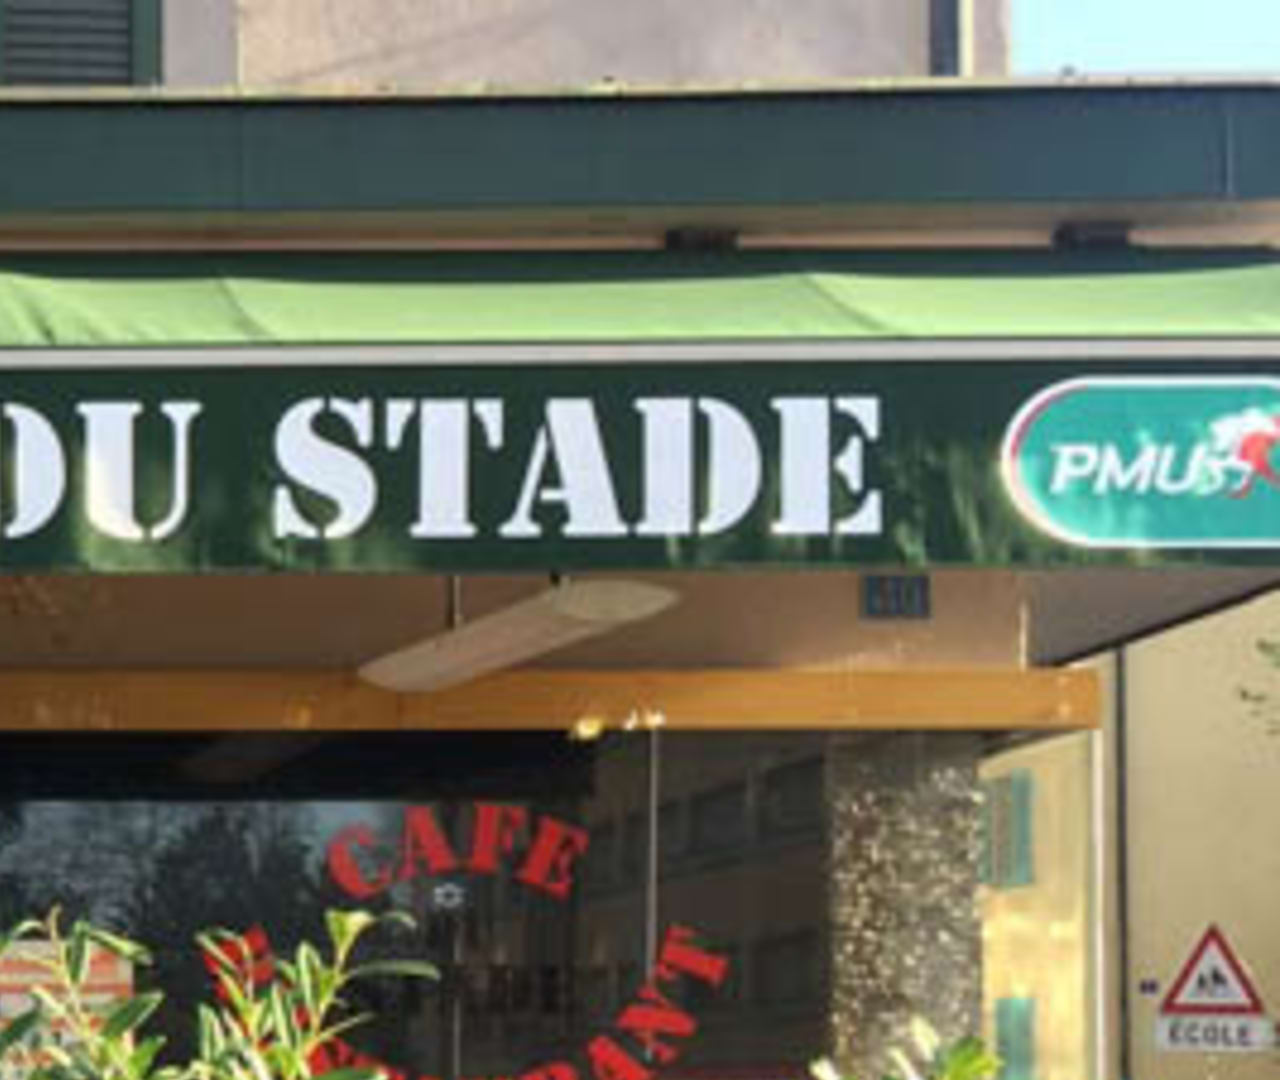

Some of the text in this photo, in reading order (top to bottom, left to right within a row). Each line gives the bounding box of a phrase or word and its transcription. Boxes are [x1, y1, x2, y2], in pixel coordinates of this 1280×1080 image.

[272, 396, 883, 539] STADE
[1050, 443, 1207, 495] PMU
[325, 803, 590, 898] CAFE
[1168, 1022, 1253, 1047] ECOLE
